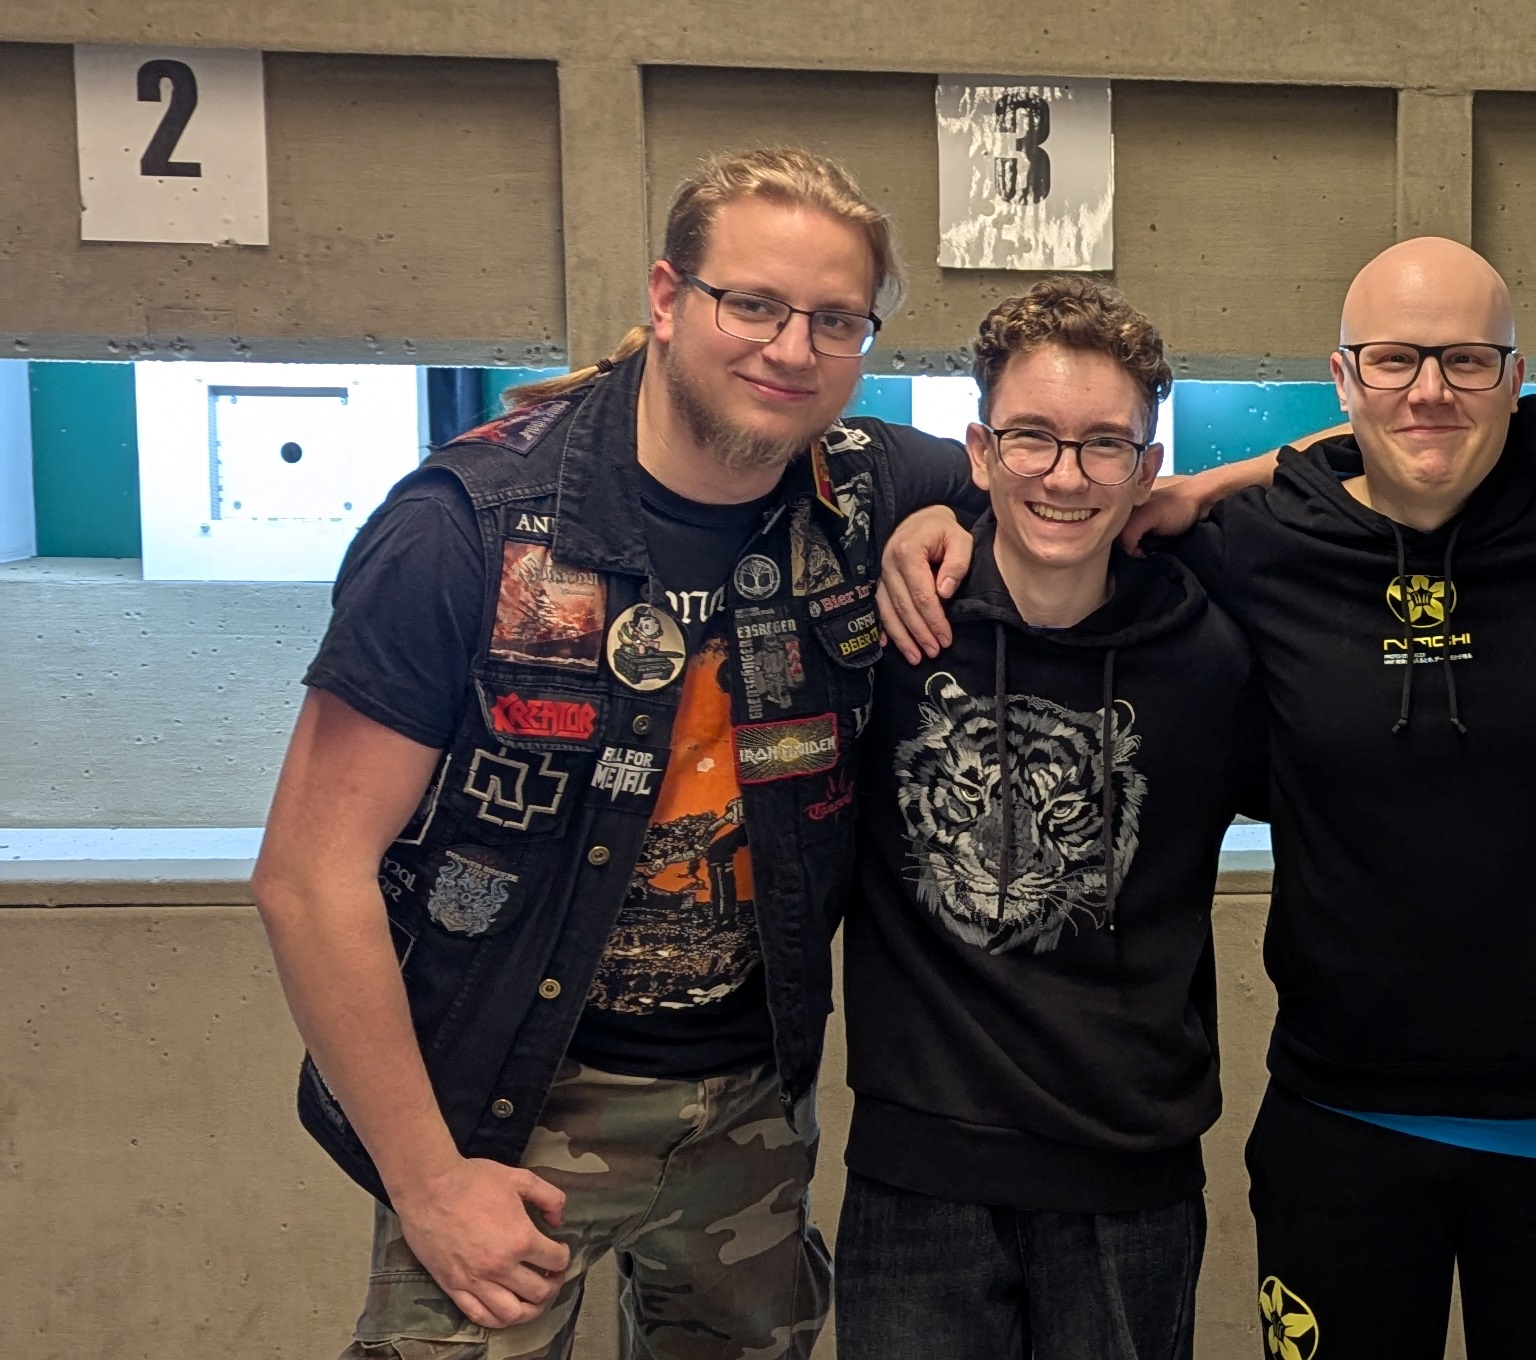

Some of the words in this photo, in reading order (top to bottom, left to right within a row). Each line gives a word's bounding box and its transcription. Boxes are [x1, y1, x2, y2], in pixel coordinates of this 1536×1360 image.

[136, 58, 203, 178] 2
[994, 93, 1051, 206] 3
[491, 692, 597, 740] KREATOR
[624, 750, 654, 767] FOR
[739, 744, 778, 765] IRON
[590, 760, 657, 802] METAL
